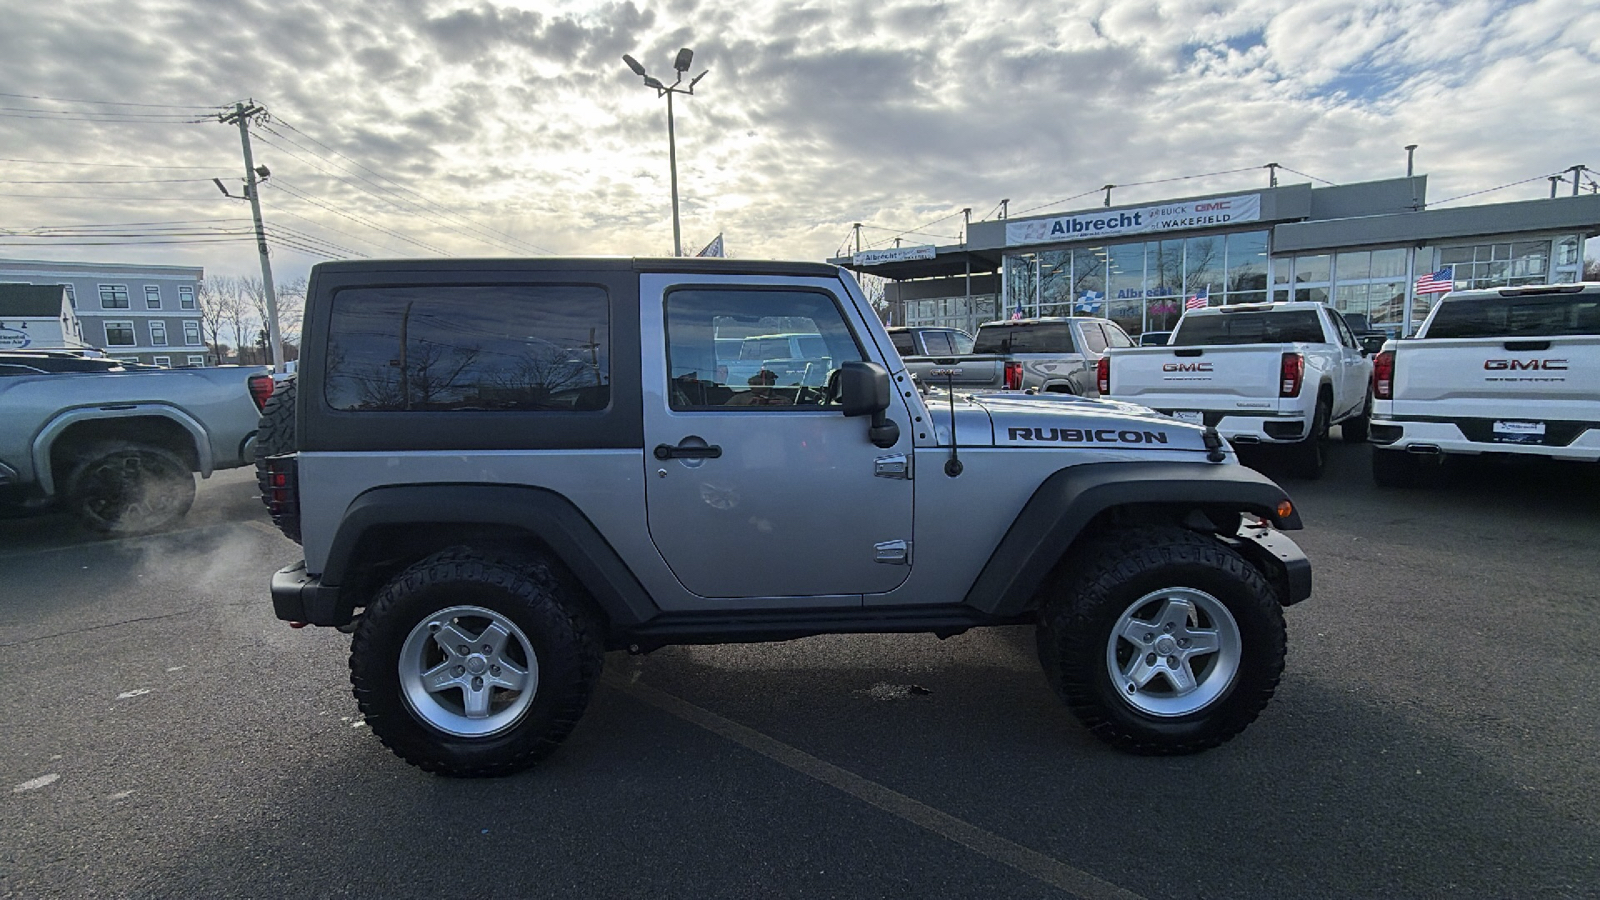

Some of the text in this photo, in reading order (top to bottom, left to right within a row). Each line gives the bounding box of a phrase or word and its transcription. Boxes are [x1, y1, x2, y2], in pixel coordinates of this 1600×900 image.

[1161, 201, 1231, 216] BUICK GMC
[1050, 211, 1142, 235] Albrecht
[1161, 214, 1231, 229] WAKEFIELD
[865, 252, 898, 261] Albrecht
[1117, 286, 1173, 299] Albrecht
[1162, 362, 1214, 372] GMC
[1484, 359, 1568, 371] GMC
[1007, 427, 1169, 444] RUBICON
